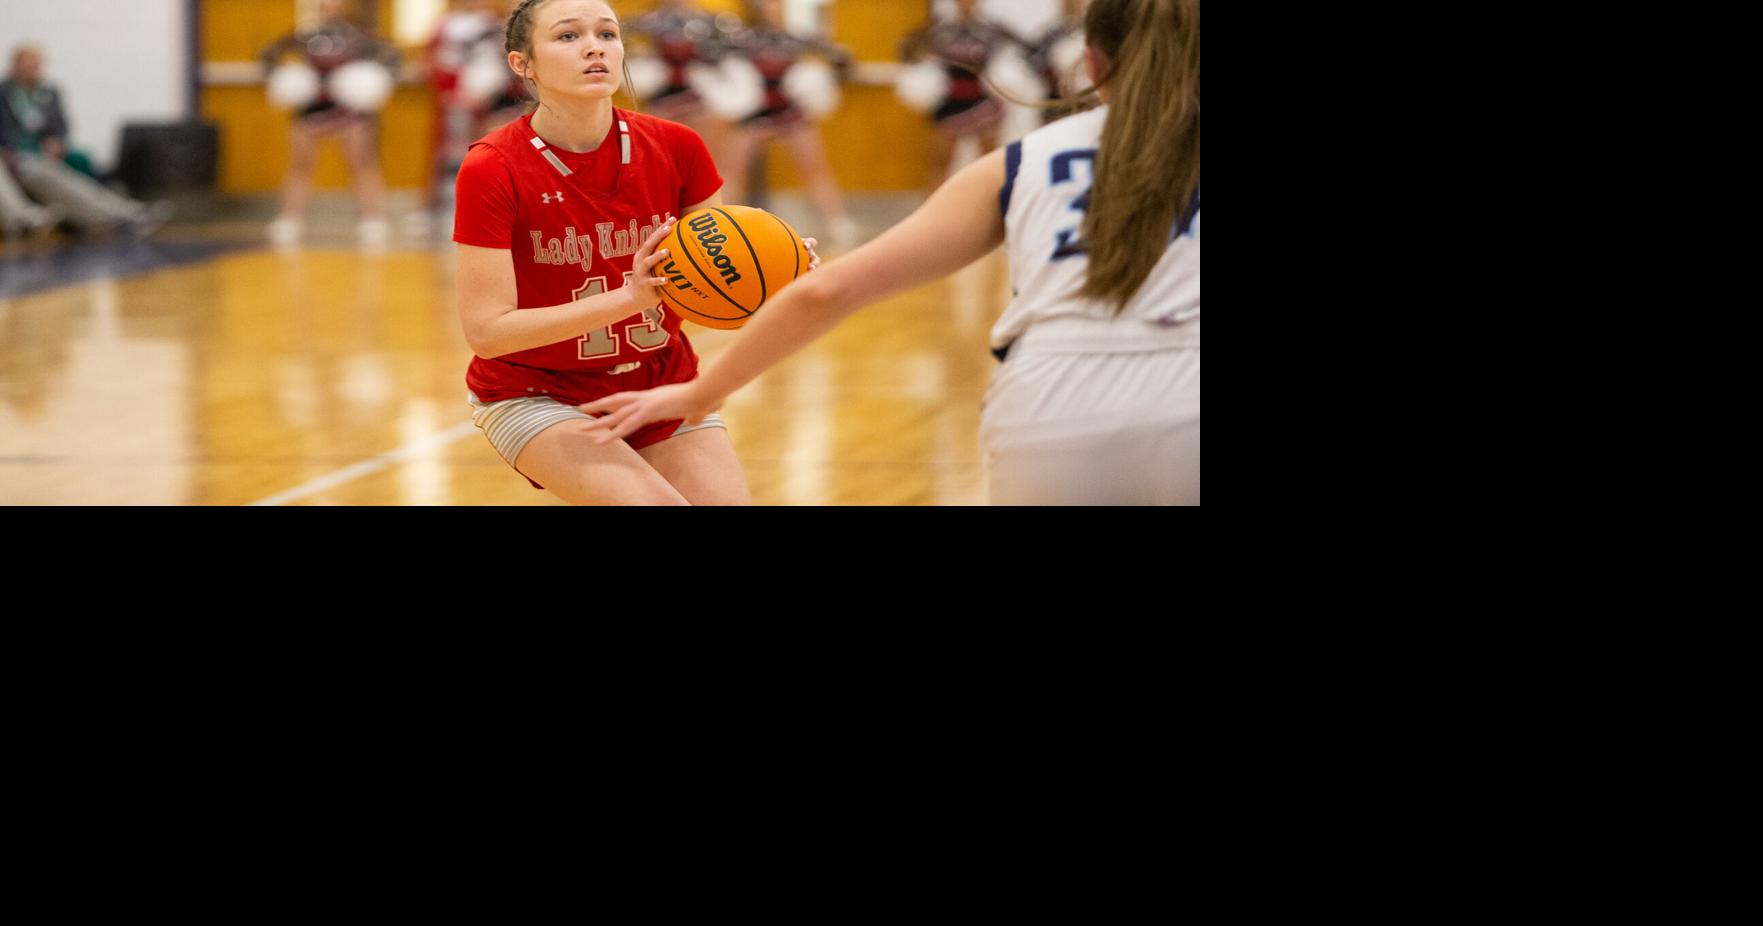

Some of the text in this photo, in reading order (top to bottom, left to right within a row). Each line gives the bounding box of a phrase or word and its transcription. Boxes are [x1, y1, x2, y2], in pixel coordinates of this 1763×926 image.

[530, 226, 593, 272] Lady
[595, 212, 671, 260] Kni
[688, 212, 742, 286] Wilson
